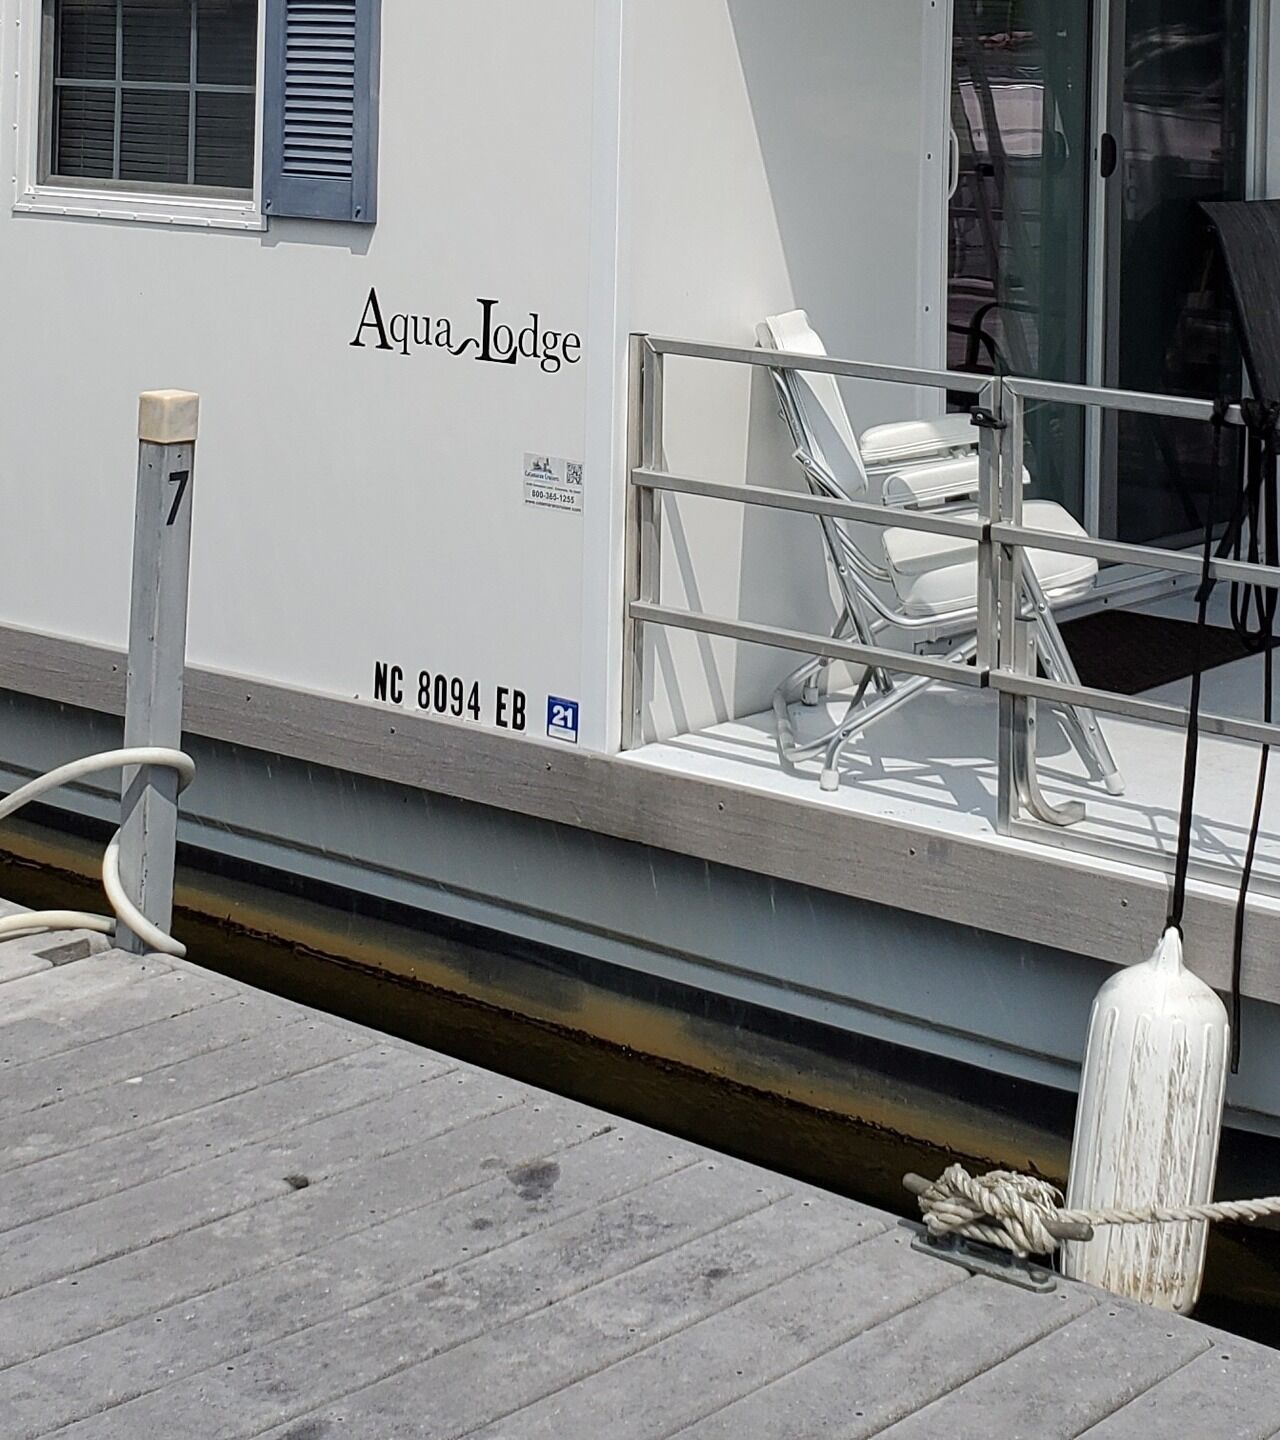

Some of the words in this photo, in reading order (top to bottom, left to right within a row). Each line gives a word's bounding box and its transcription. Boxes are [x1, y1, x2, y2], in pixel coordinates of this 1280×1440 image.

[349, 286, 457, 357] Aqua
[473, 297, 582, 374] Lodge
[166, 470, 190, 526] 7
[373, 661, 404, 705] NC
[417, 670, 481, 721] 8094
[495, 686, 527, 731] EB
[551, 705, 573, 729] 21
